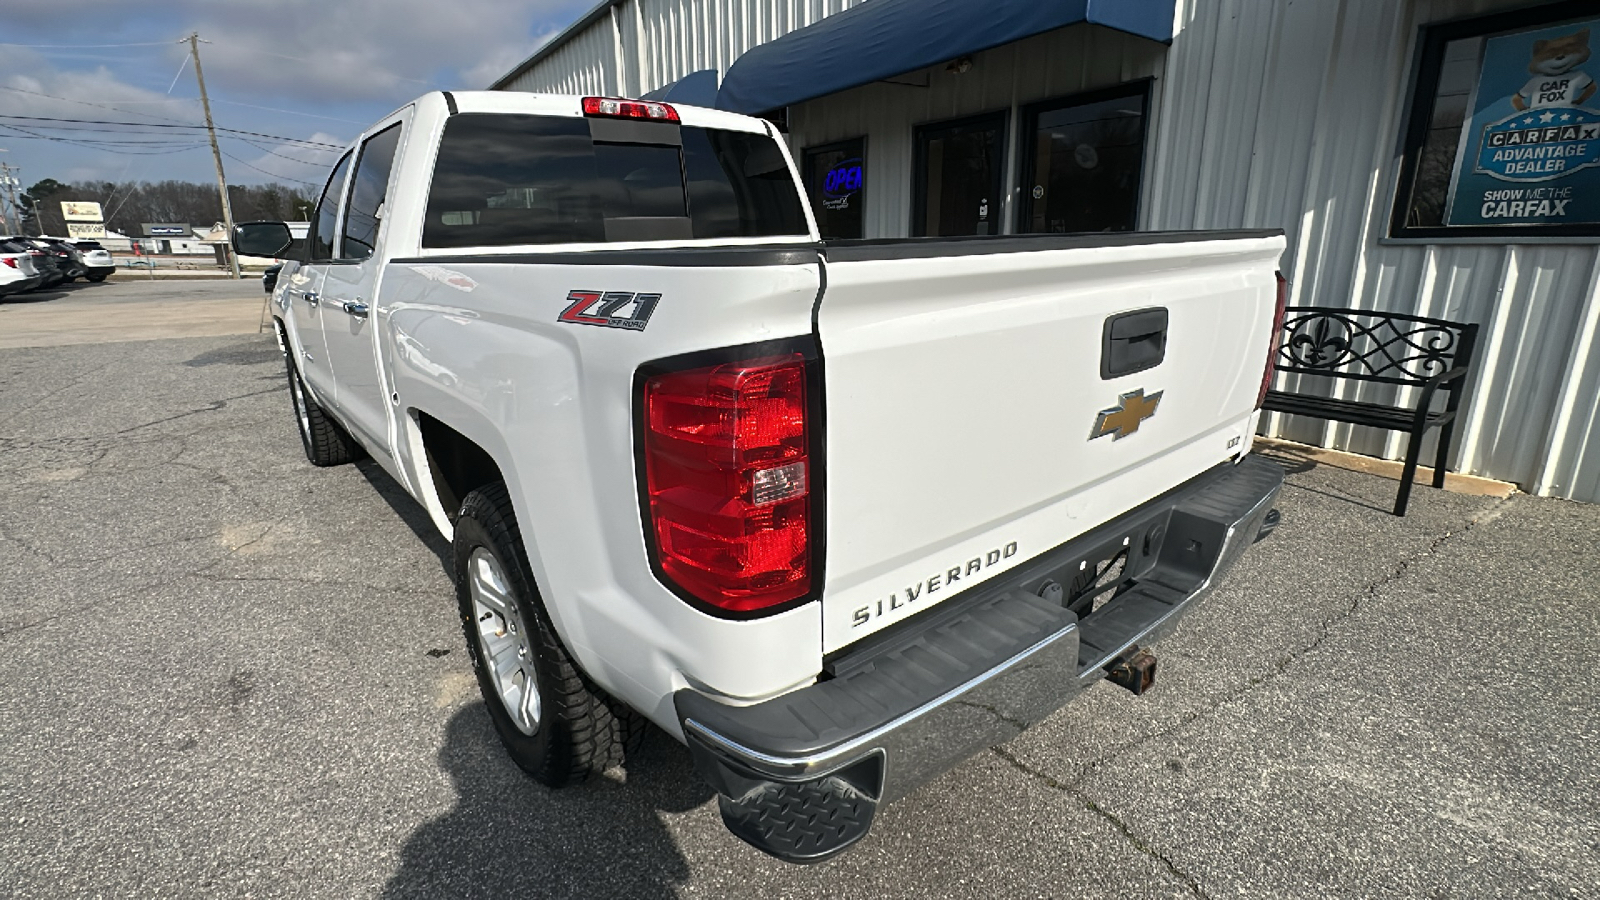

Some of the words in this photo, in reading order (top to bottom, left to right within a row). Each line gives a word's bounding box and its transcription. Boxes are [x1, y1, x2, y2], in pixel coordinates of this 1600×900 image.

[1540, 79, 1570, 92] CAR
[1539, 90, 1566, 103] FOX
[1491, 127, 1597, 146] CARFAX
[1492, 143, 1587, 162] ADVANTAGE
[1504, 160, 1566, 175] DEALER
[825, 166, 863, 192] OPEN
[1483, 189, 1524, 201] SHOW
[1525, 188, 1546, 200] ME
[1546, 187, 1573, 199] THE
[1481, 199, 1570, 218] CARFAX
[557, 290, 662, 326] Z71
[851, 541, 1018, 628] SILVERADO
